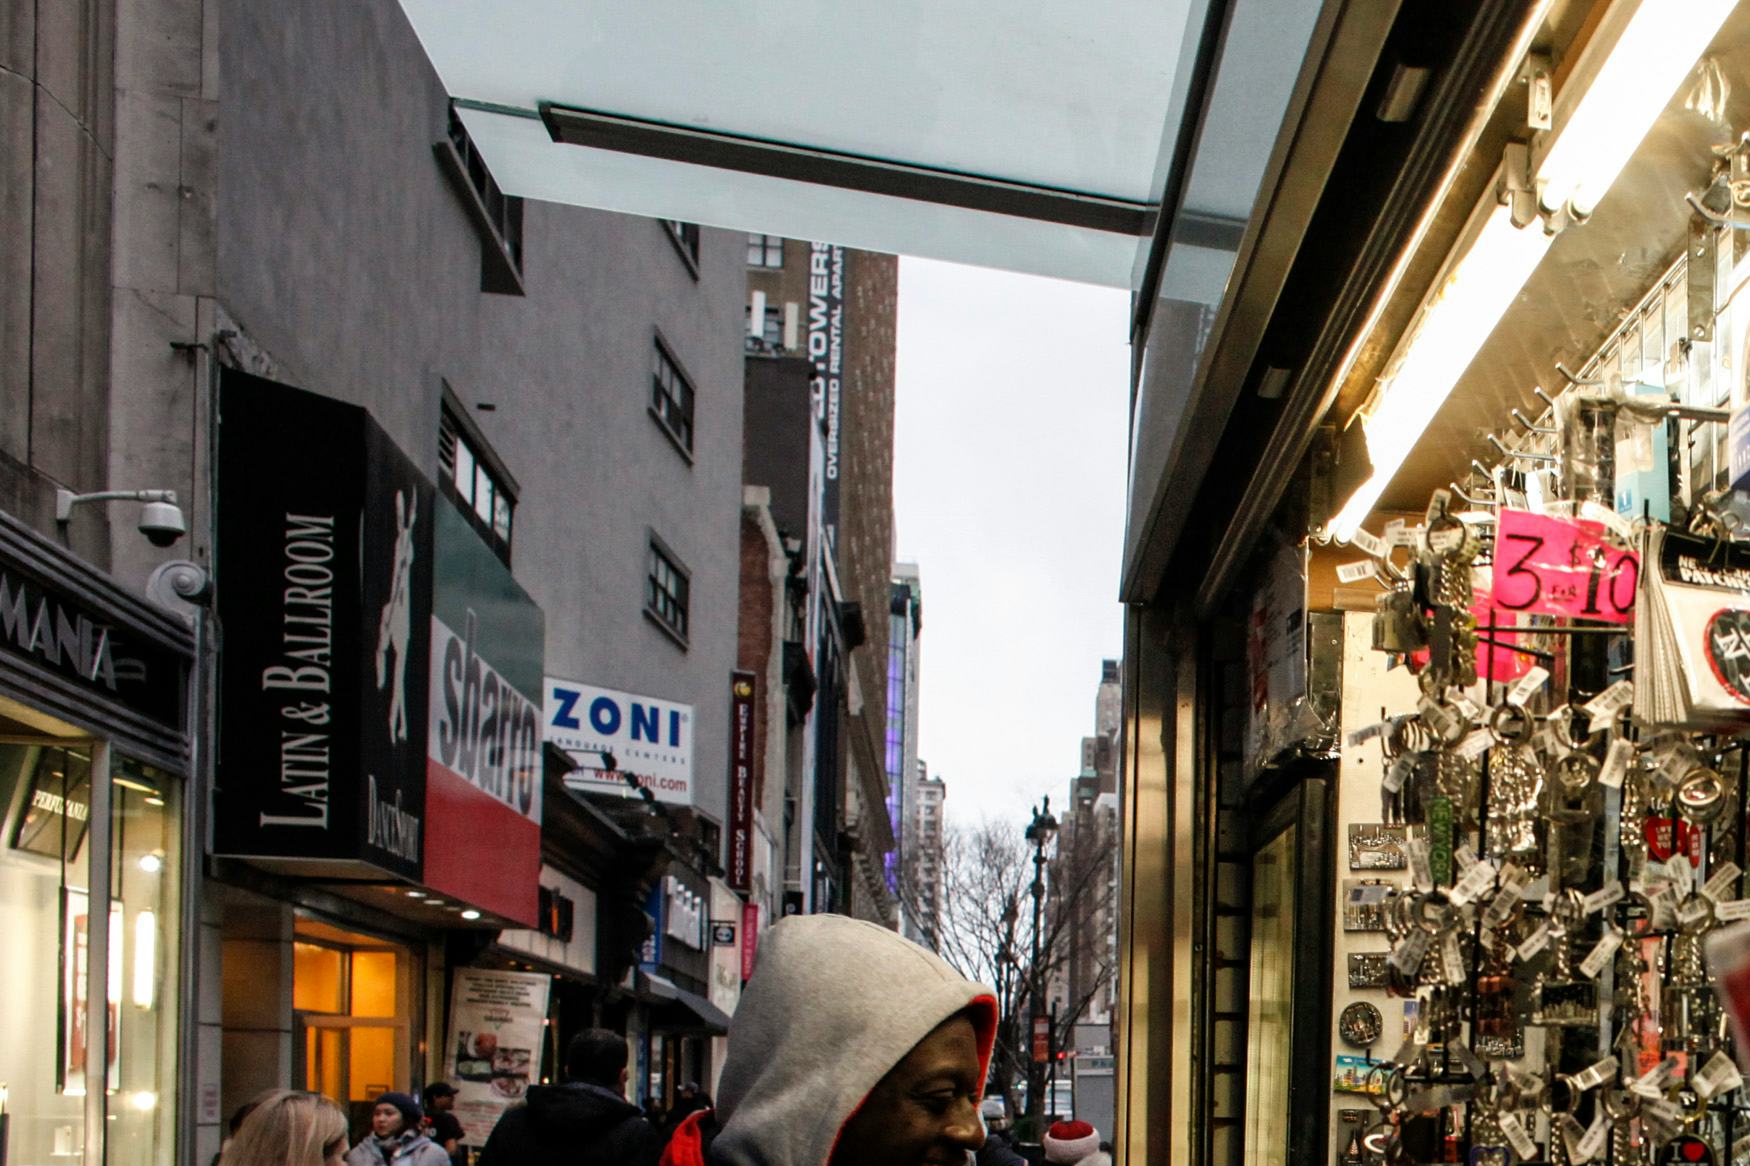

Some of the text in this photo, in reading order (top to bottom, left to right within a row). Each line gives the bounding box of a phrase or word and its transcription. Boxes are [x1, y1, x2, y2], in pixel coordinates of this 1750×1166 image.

[829, 304, 843, 374] RENTAL
[826, 378, 840, 480] OVERSIZED
[1496, 533, 1544, 610] 3
[259, 511, 335, 832] LATIN & BALLROOM
[439, 607, 536, 816] sbarro
[552, 687, 681, 748] ZONI
[625, 748, 686, 765] CENTERS
